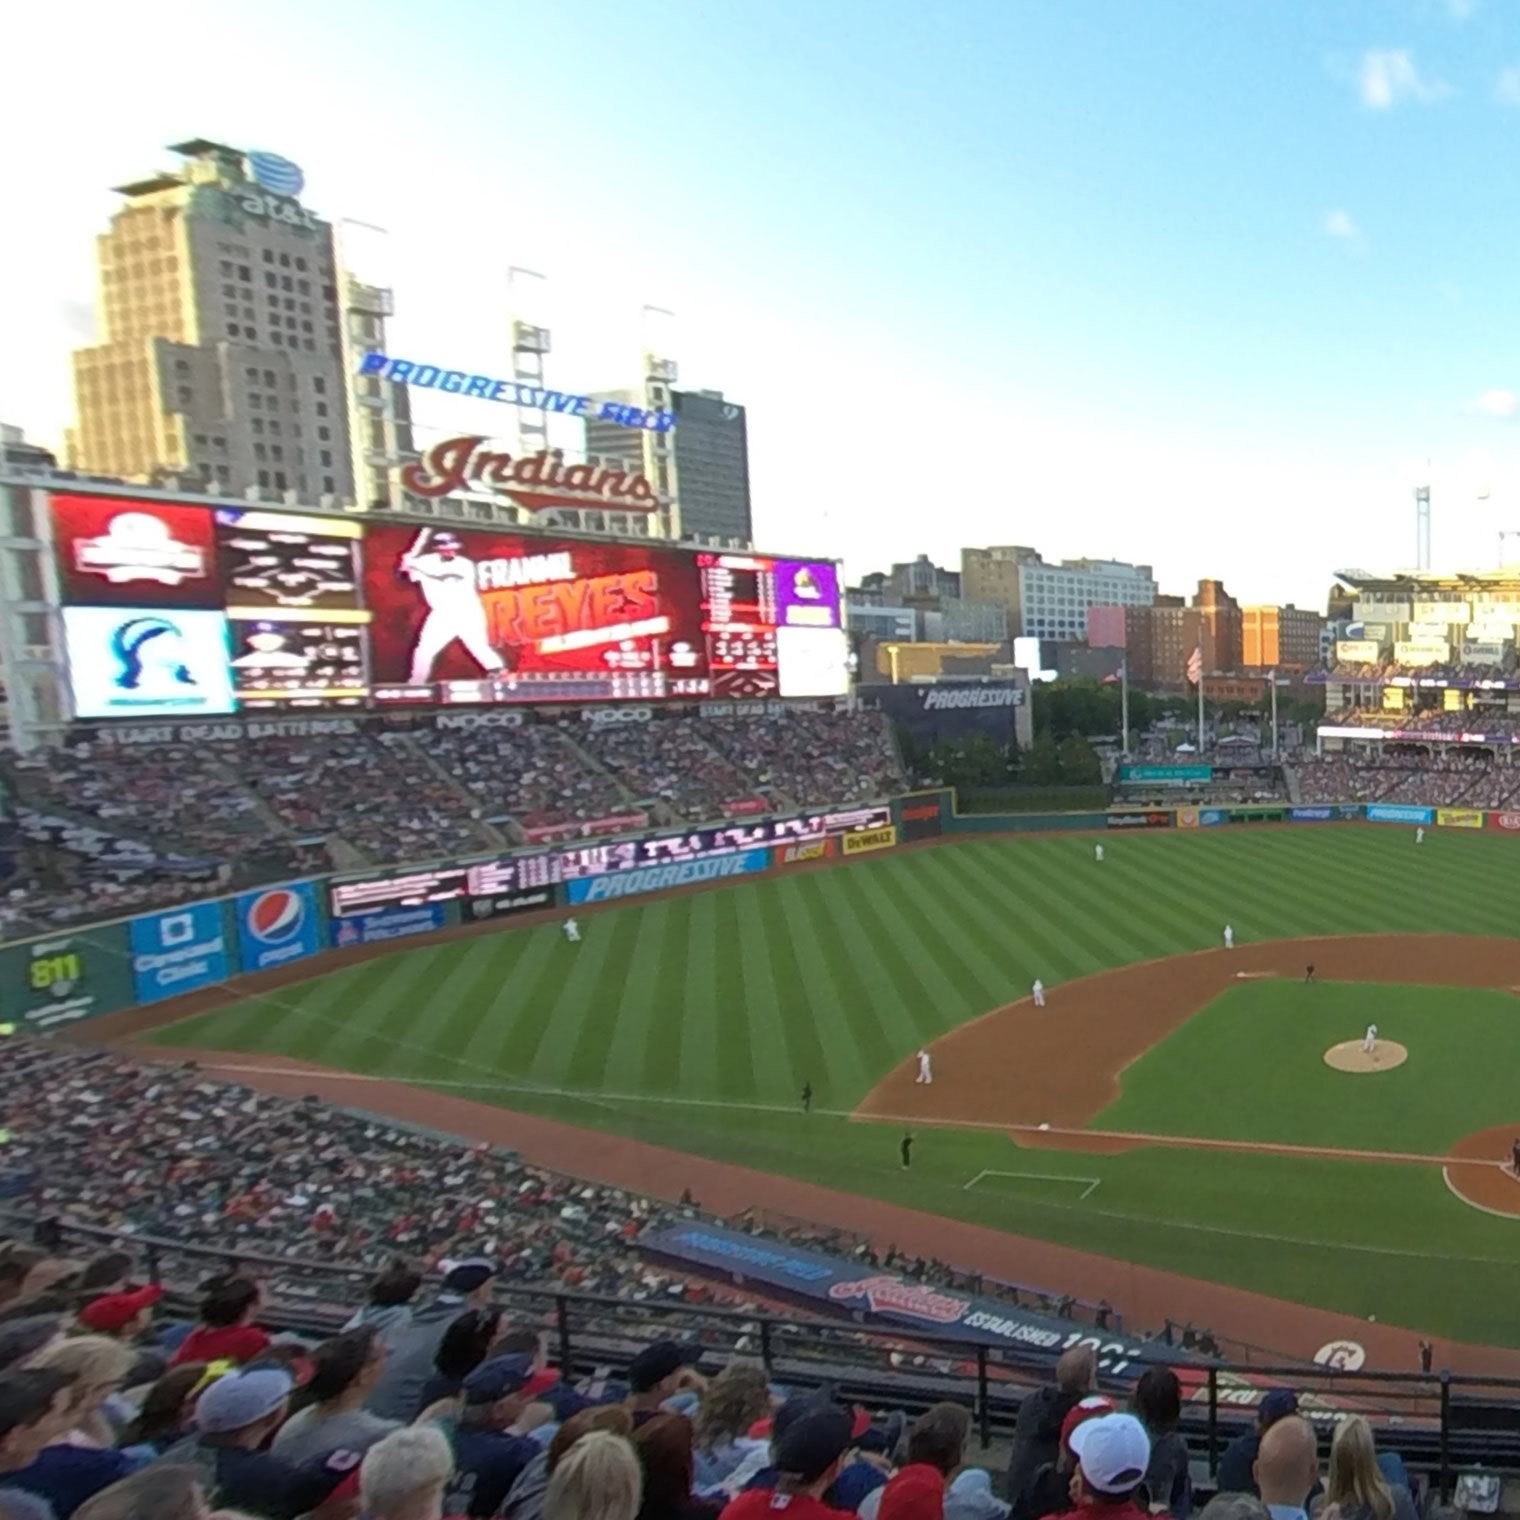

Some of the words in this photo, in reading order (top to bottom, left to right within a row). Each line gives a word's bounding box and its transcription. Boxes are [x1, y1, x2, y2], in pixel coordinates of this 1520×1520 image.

[241, 194, 317, 231] at&t
[360, 351, 592, 416] PROGRESSIVE
[402, 436, 658, 512] Indians
[481, 570, 659, 648] REYES
[581, 707, 653, 723] NOCO
[923, 688, 1022, 710] PROGRESSIVE
[99, 728, 173, 745] START
[180, 724, 243, 742] DEAD
[437, 709, 523, 728] NOCO
[585, 852, 748, 902] PROGRESSIVE
[30, 954, 80, 988] 811
[963, 1311, 1062, 1348] ESTABLISHED
